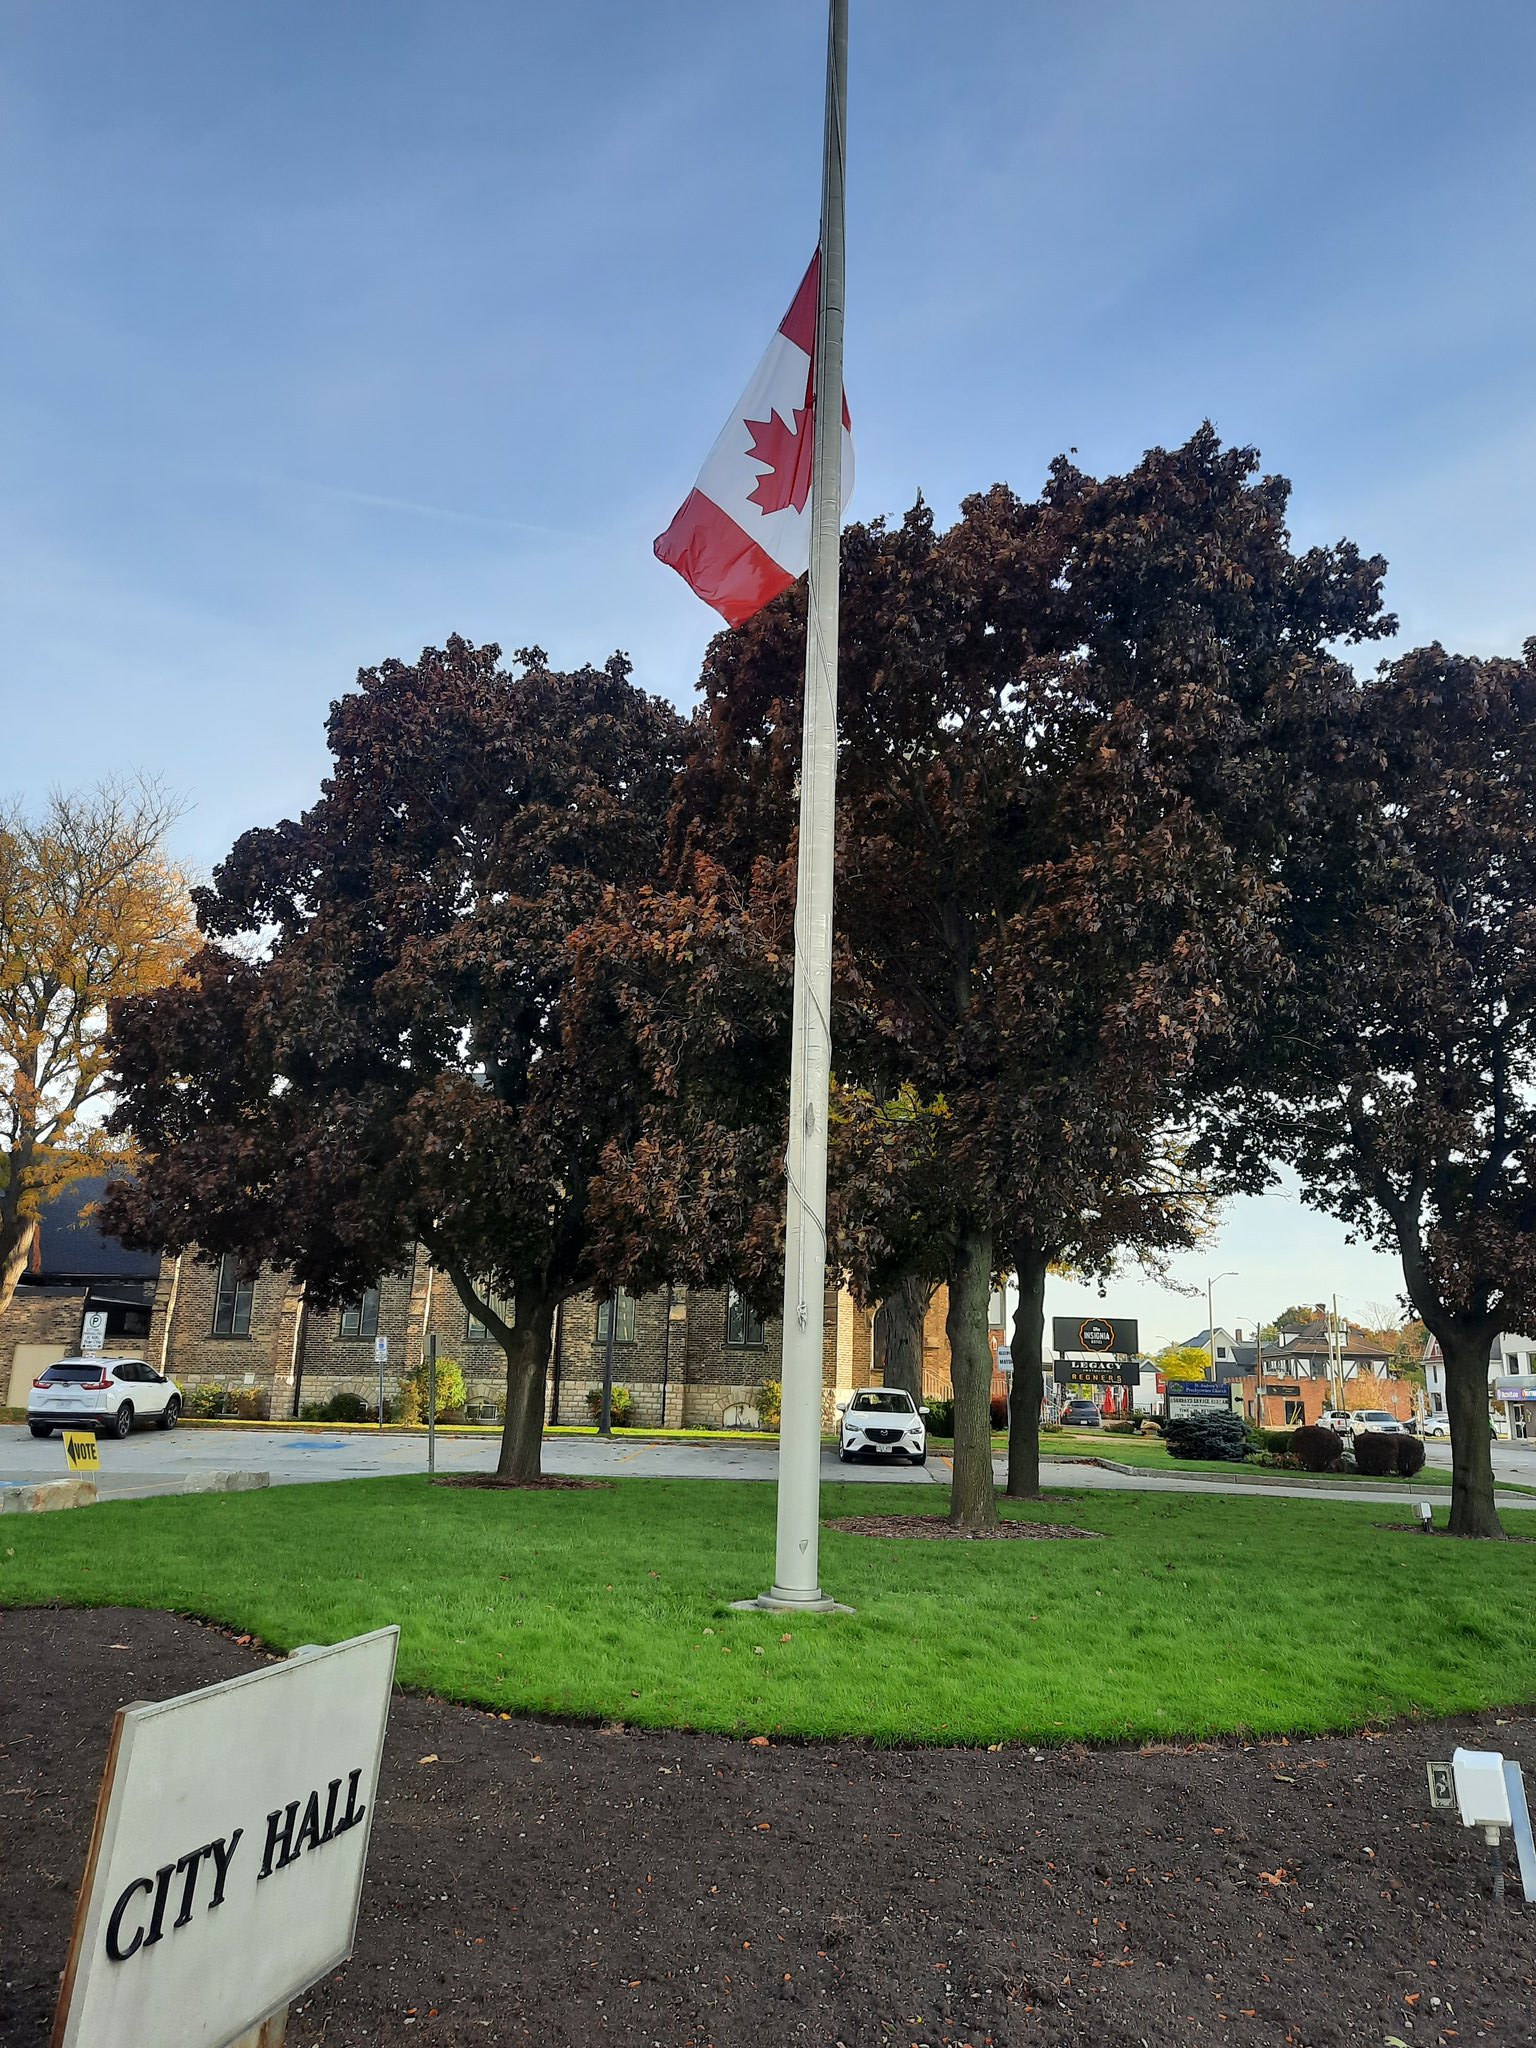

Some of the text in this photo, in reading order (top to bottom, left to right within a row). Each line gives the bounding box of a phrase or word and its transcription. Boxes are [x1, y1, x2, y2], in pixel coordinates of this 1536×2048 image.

[1083, 1331, 1110, 1340] INSIGNIA
[1071, 1361, 1122, 1370] LEGACY
[1071, 1373, 1122, 1383] REGNERS
[74, 1443, 97, 1460] VOTE
[106, 1768, 366, 1961] CITY HALL
